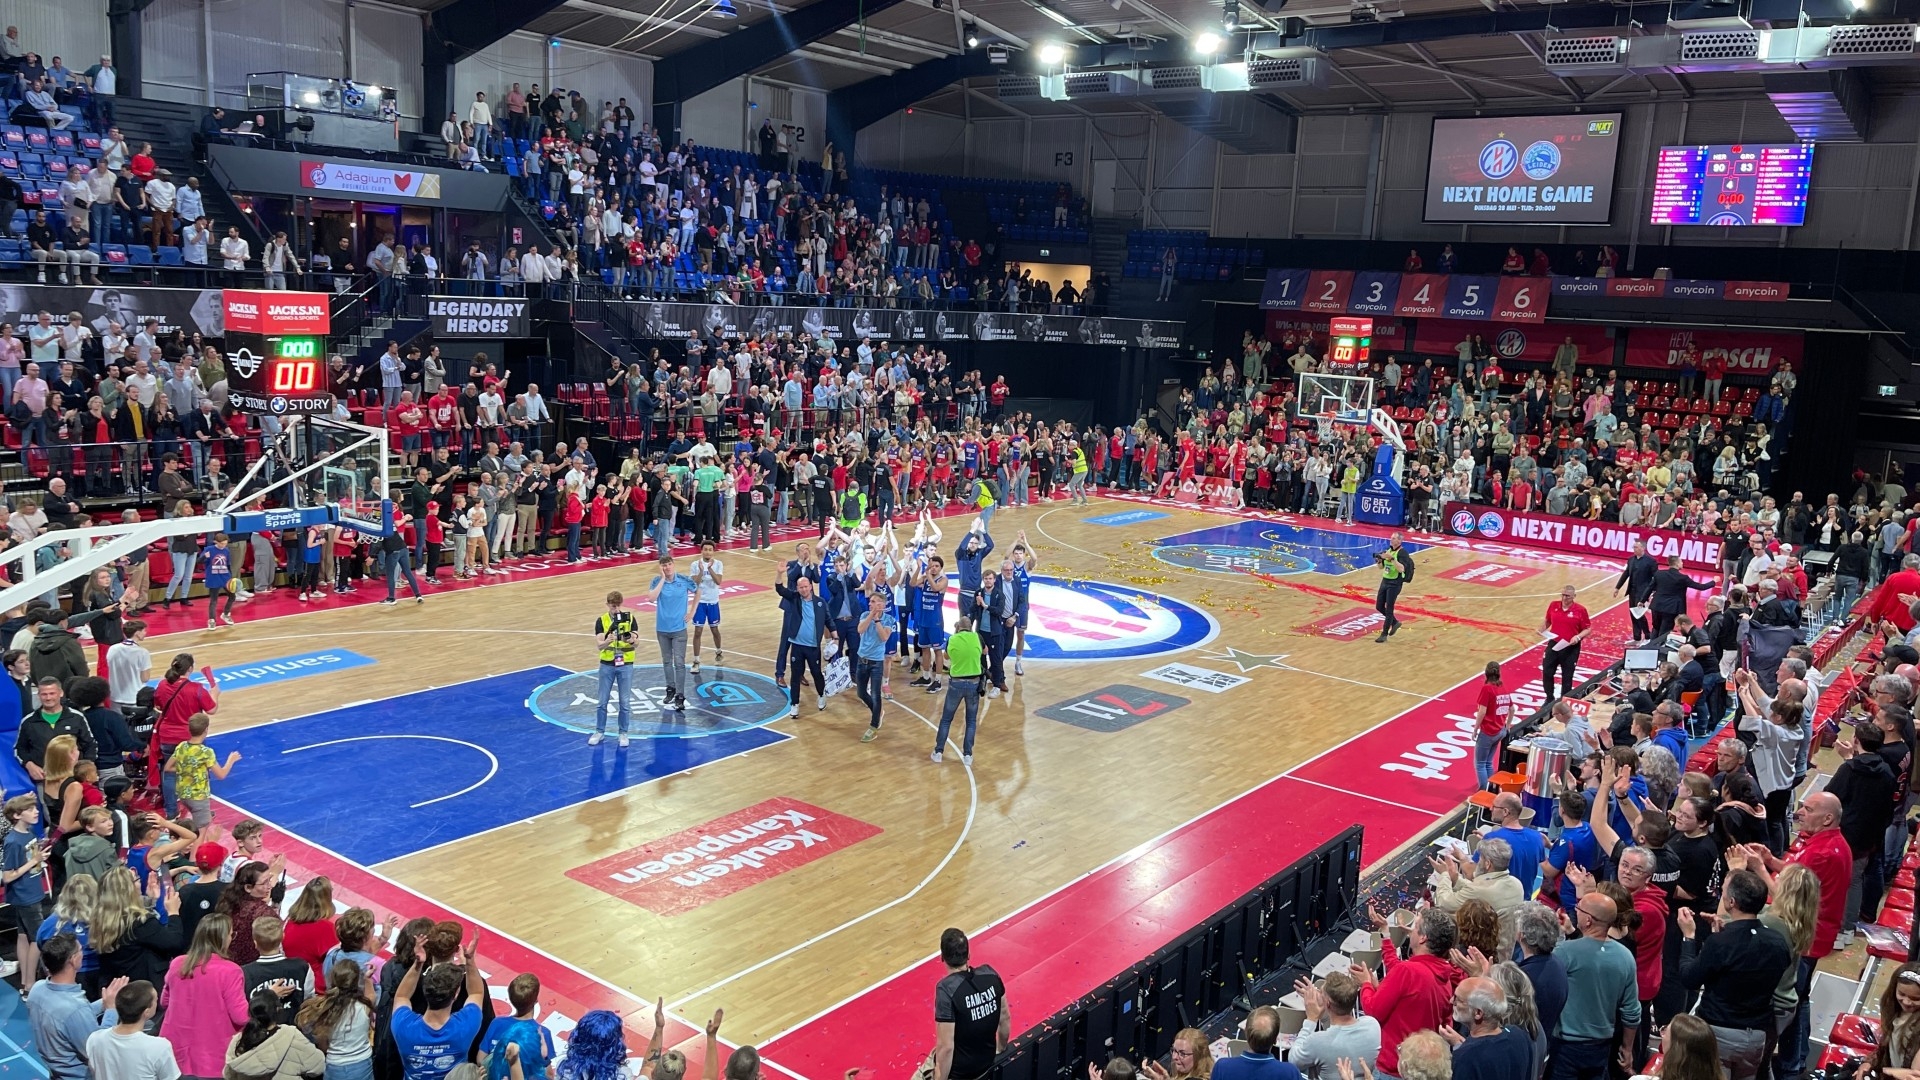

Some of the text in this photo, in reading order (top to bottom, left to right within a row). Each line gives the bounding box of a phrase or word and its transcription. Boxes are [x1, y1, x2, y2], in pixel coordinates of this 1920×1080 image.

[1055, 152, 1074, 166] F3
[1713, 163, 1726, 172] 90
[1740, 163, 1753, 172] 83
[334, 170, 392, 184] Adagium
[1726, 180, 1734, 189] 4
[1443, 186, 1594, 202] NEXT HOME GAME
[1717, 193, 1745, 204] 0:00
[1280, 279, 1291, 298] 1
[1320, 280, 1337, 300] 2
[1366, 281, 1383, 302] 3
[1560, 283, 1598, 292] anycoin
[1615, 283, 1655, 293] anycoin
[1673, 285, 1715, 295] anycoin
[1734, 287, 1778, 296] anycoin
[1413, 284, 1430, 305] 4
[1462, 285, 1480, 306] 5
[1514, 287, 1530, 309] 6
[229, 302, 259, 315] JACKS.NL
[1266, 298, 1296, 306] anycoin
[1309, 301, 1340, 309] anycoin
[1354, 303, 1387, 311] anycoin
[267, 305, 325, 316] JACKS.NL
[428, 301, 525, 317] LEGENDARY
[1402, 305, 1435, 314] anycoin
[1450, 308, 1484, 316] anycoin
[1500, 310, 1537, 318] anycoin
[446, 318, 509, 333] HEROES
[1669, 331, 1694, 347] HEYA
[1334, 347, 1353, 360] 00
[239, 359, 252, 367] MINI
[274, 362, 315, 390] 00
[245, 396, 267, 410] STORY
[289, 398, 330, 411] STORY
[1373, 498, 1389, 506] BET
[265, 512, 301, 521] Schelde
[1372, 506, 1392, 514] CITY
[265, 518, 301, 527] Sports
[1511, 516, 1720, 564] NEXT HOME GAME
[608, 809, 817, 884] Kampioen
[669, 828, 829, 887] Keuken
[965, 985, 997, 1009] GAMEDAY
[970, 1000, 998, 1021] HEROES
